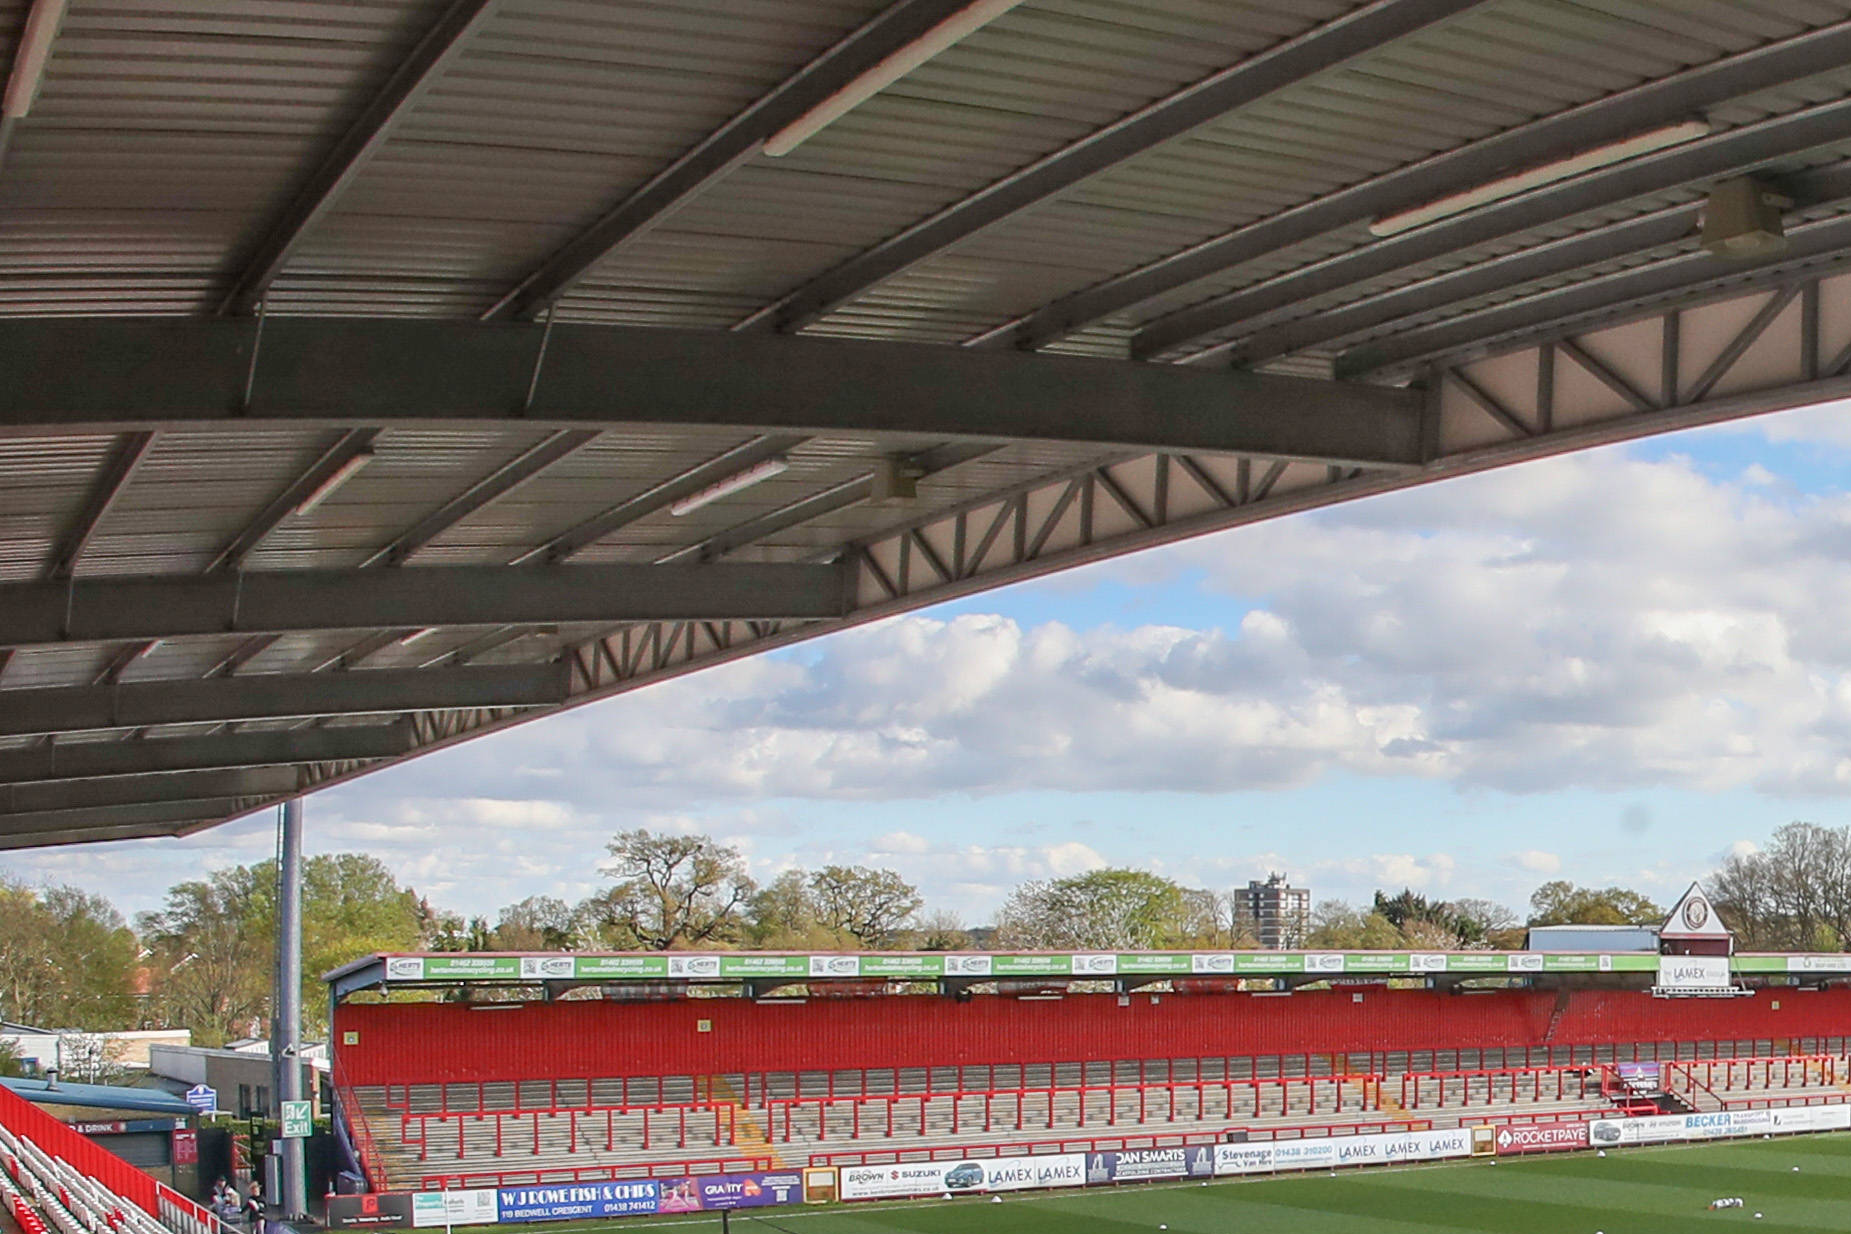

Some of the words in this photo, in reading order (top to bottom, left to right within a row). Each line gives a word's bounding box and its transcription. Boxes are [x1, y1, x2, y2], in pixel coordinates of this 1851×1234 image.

[1673, 968, 1706, 980] LAMEX
[285, 1120, 309, 1134] Exit
[1686, 1113, 1732, 1128] BECKER
[86, 1123, 113, 1133] DRINK
[1513, 1128, 1587, 1145] ROCKETPAYE
[1222, 1150, 1272, 1161] Stevenage
[1339, 1144, 1377, 1159] LAMEX
[1385, 1141, 1421, 1156] LAMEX
[1430, 1138, 1464, 1153] LAMEX
[1117, 1151, 1141, 1165] DAN
[1142, 1149, 1186, 1163] SMARTS
[902, 1170, 941, 1179] SUZUKI
[988, 1167, 1033, 1184] LAMEX
[1038, 1165, 1081, 1181] LAMEX
[502, 1191, 517, 1206] W
[529, 1188, 568, 1205] ROWE
[570, 1187, 602, 1203] FISH
[603, 1186, 614, 1200] &
[615, 1183, 655, 1200] CHIPS
[514, 1207, 550, 1218] BEDWELL
[552, 1204, 594, 1216] CRESCENT
